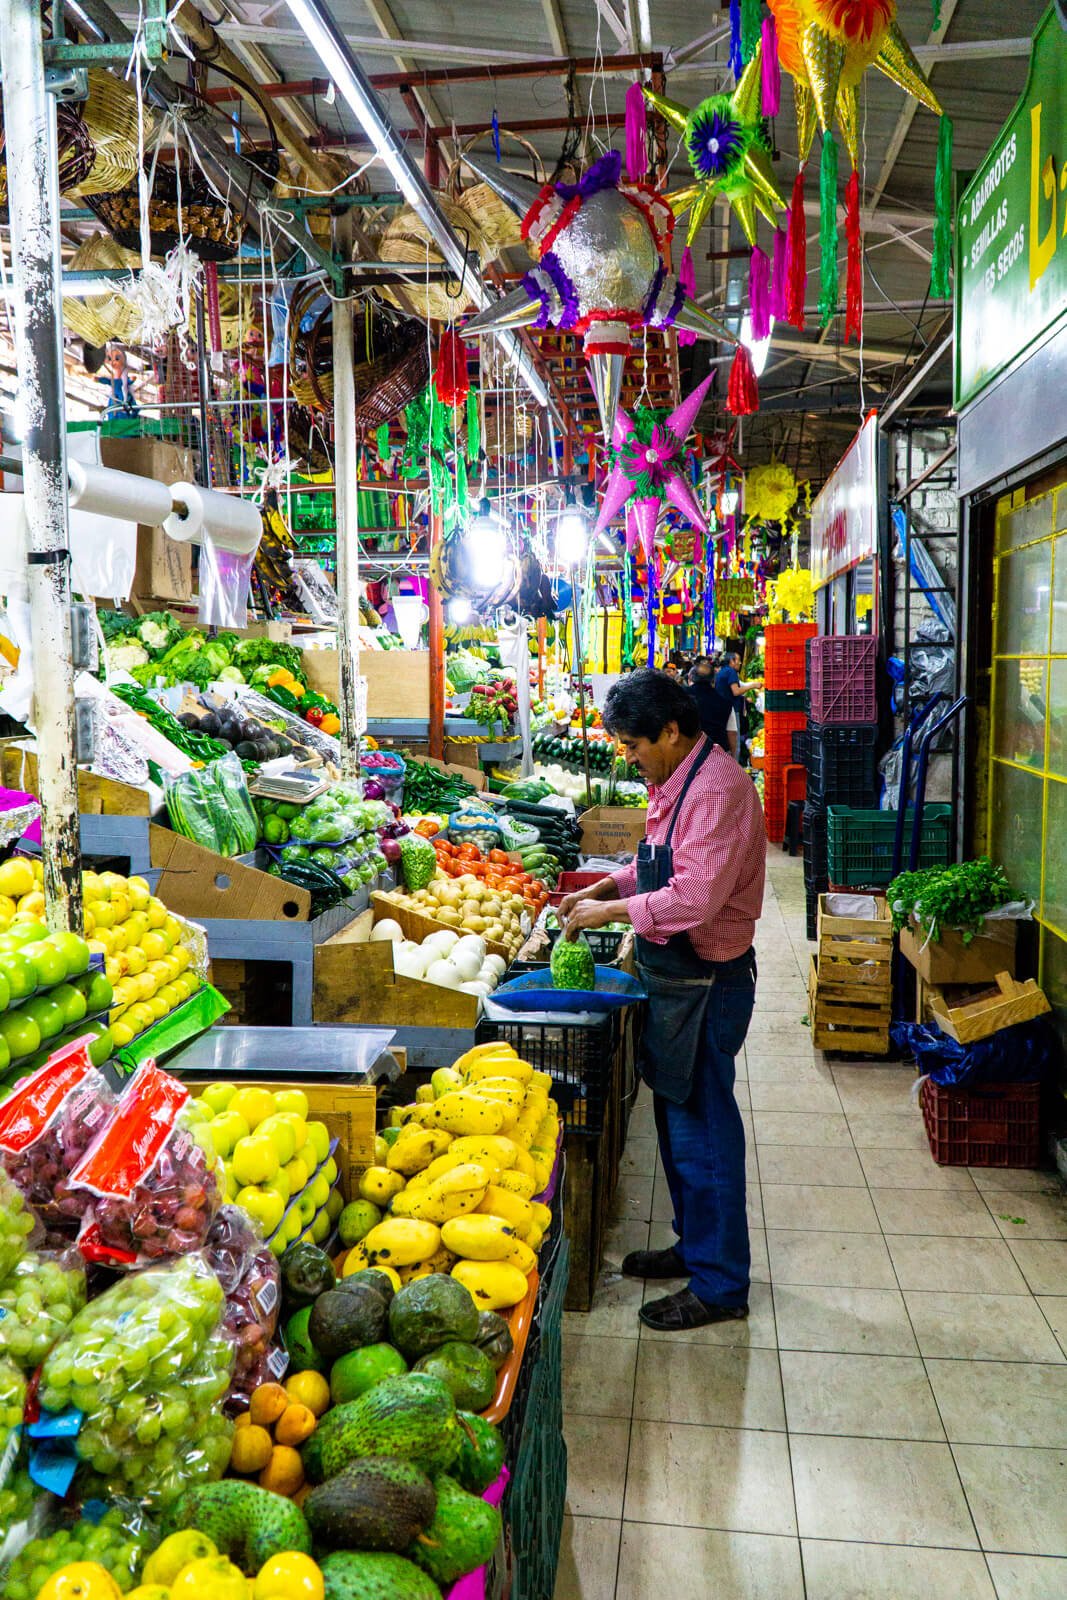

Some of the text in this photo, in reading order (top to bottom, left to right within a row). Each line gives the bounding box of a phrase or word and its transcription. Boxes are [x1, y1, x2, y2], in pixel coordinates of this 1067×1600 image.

[970, 133, 1017, 226] ABARROTES
[971, 198, 1008, 270] SEMILLAS
[997, 223, 1025, 281] SECOS
